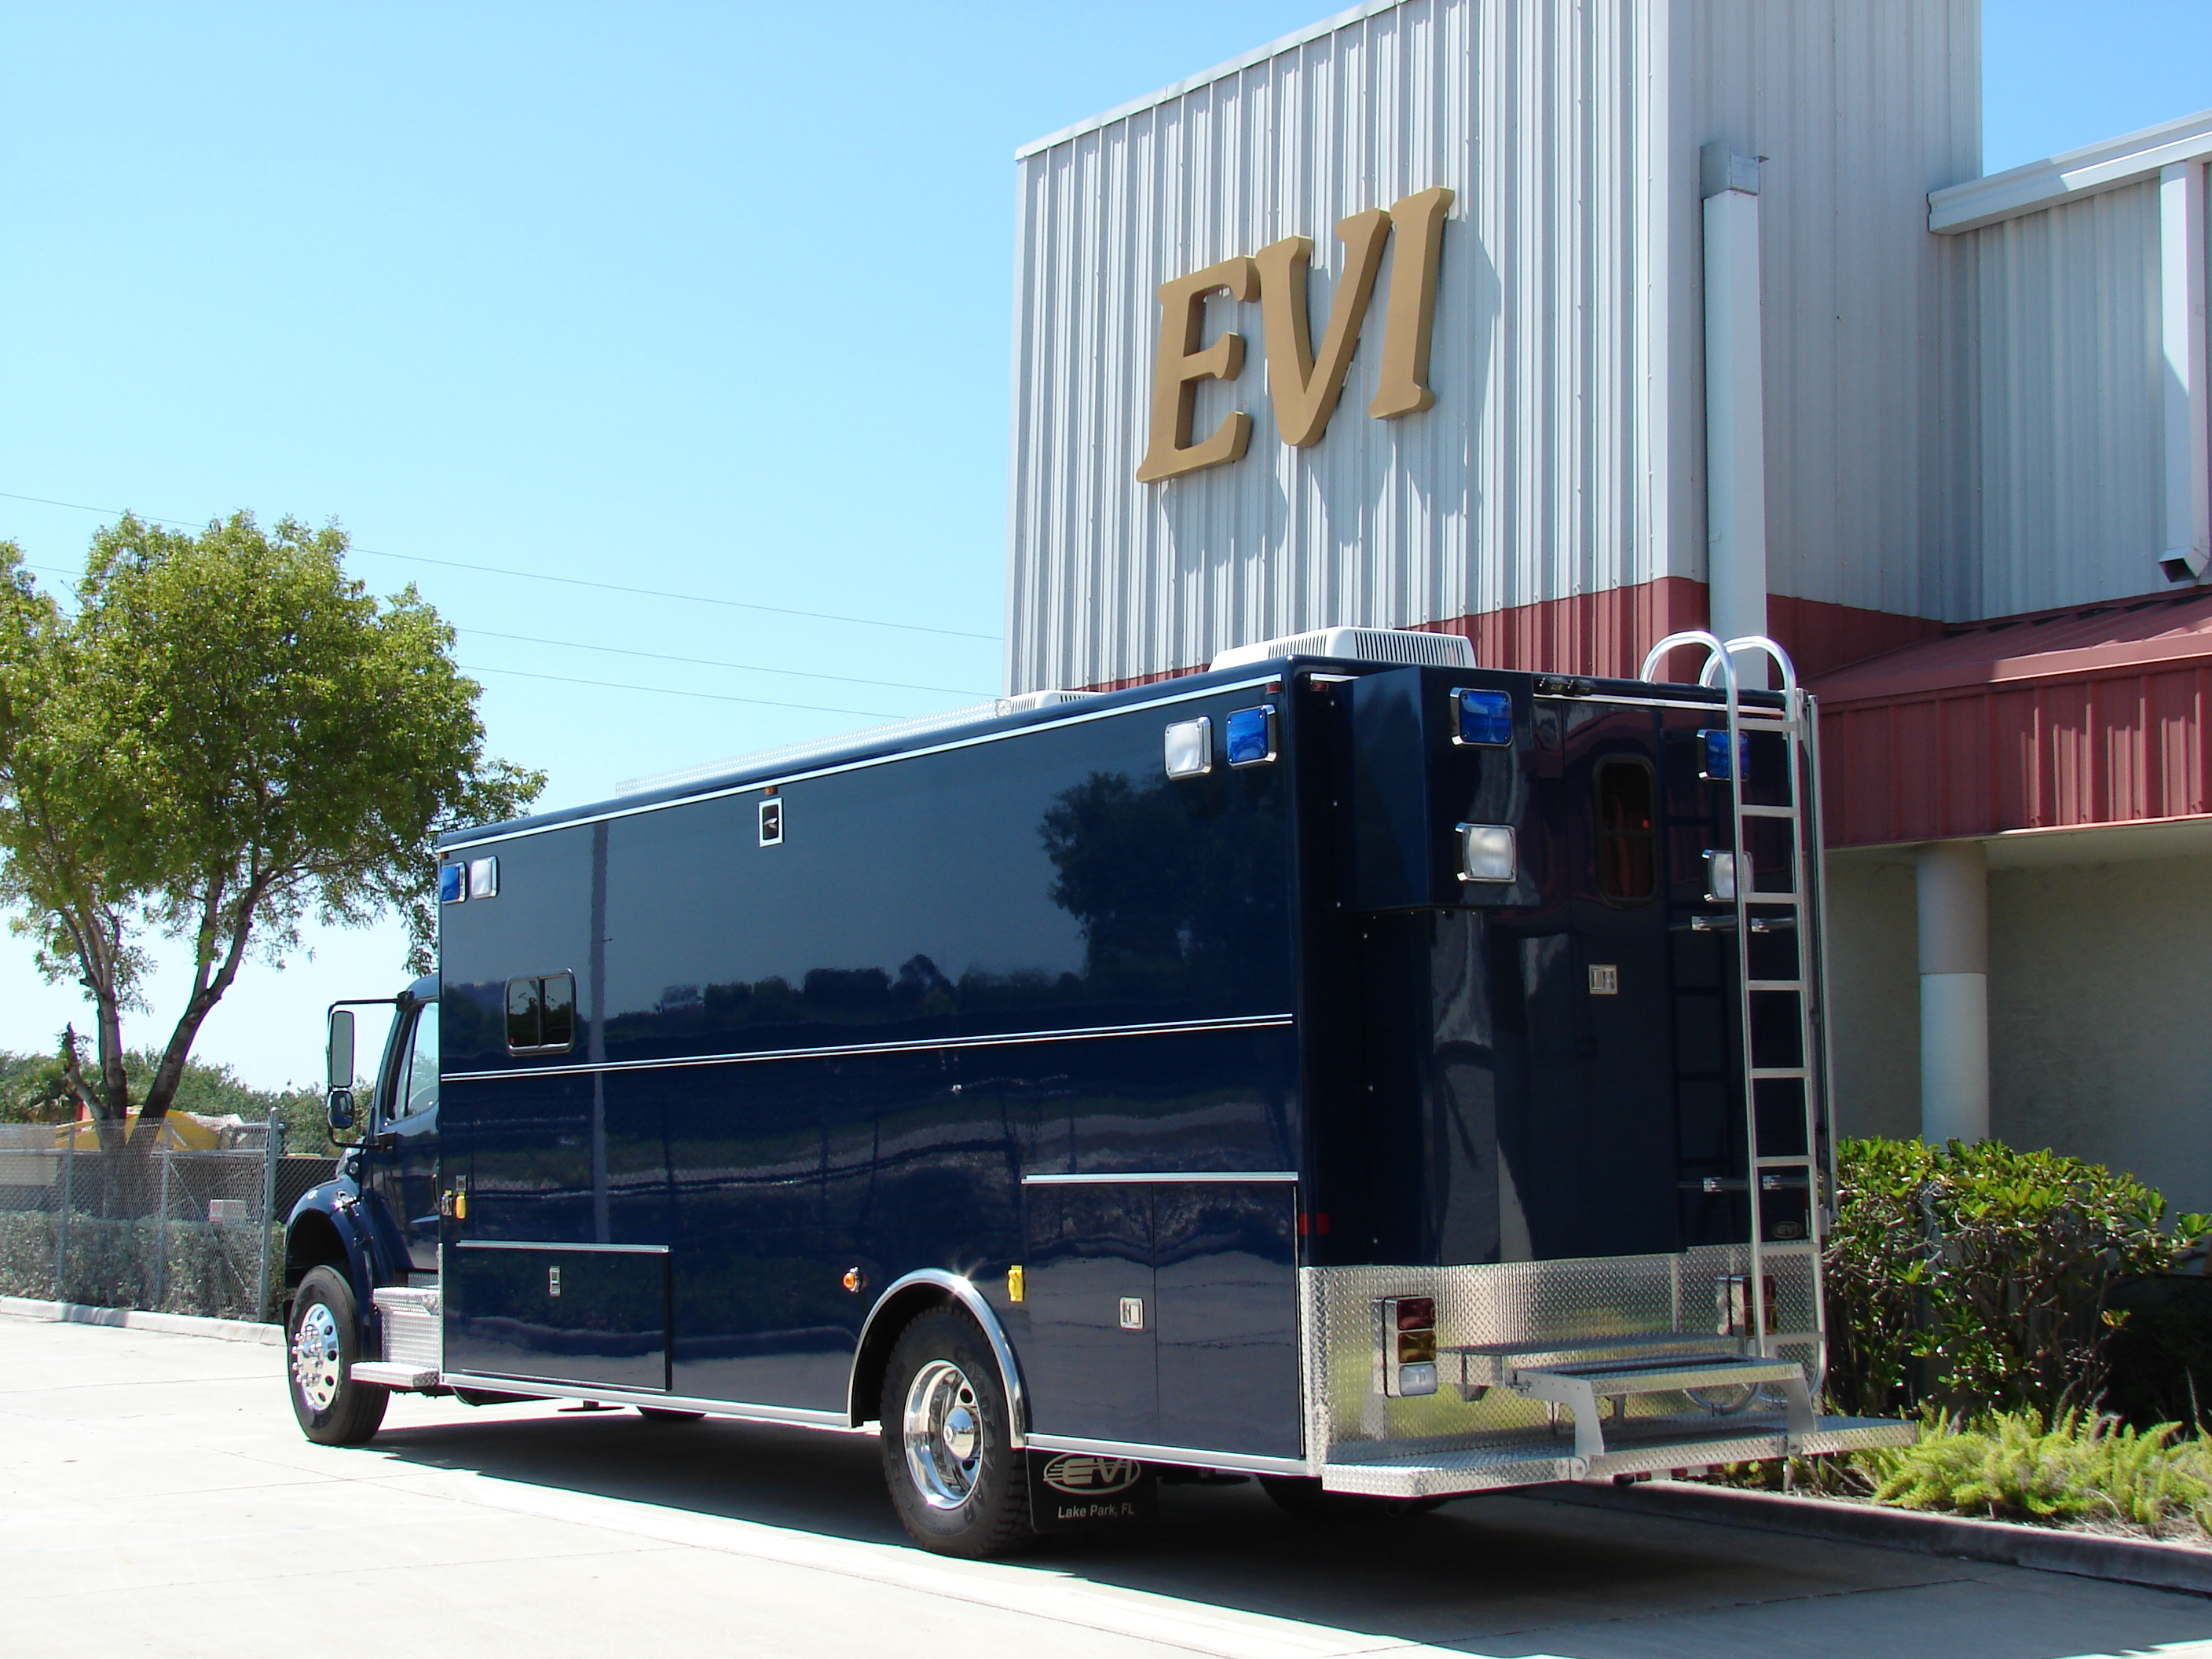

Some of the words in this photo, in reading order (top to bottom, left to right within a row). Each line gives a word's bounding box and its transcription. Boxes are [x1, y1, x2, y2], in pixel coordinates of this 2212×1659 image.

[1136, 185, 1455, 484] EVI
[1049, 1457, 1133, 1485] EVI
[1057, 1506, 1086, 1519] Lake
[1090, 1504, 1118, 1518] Park,
[1122, 1503, 1134, 1515] FL
